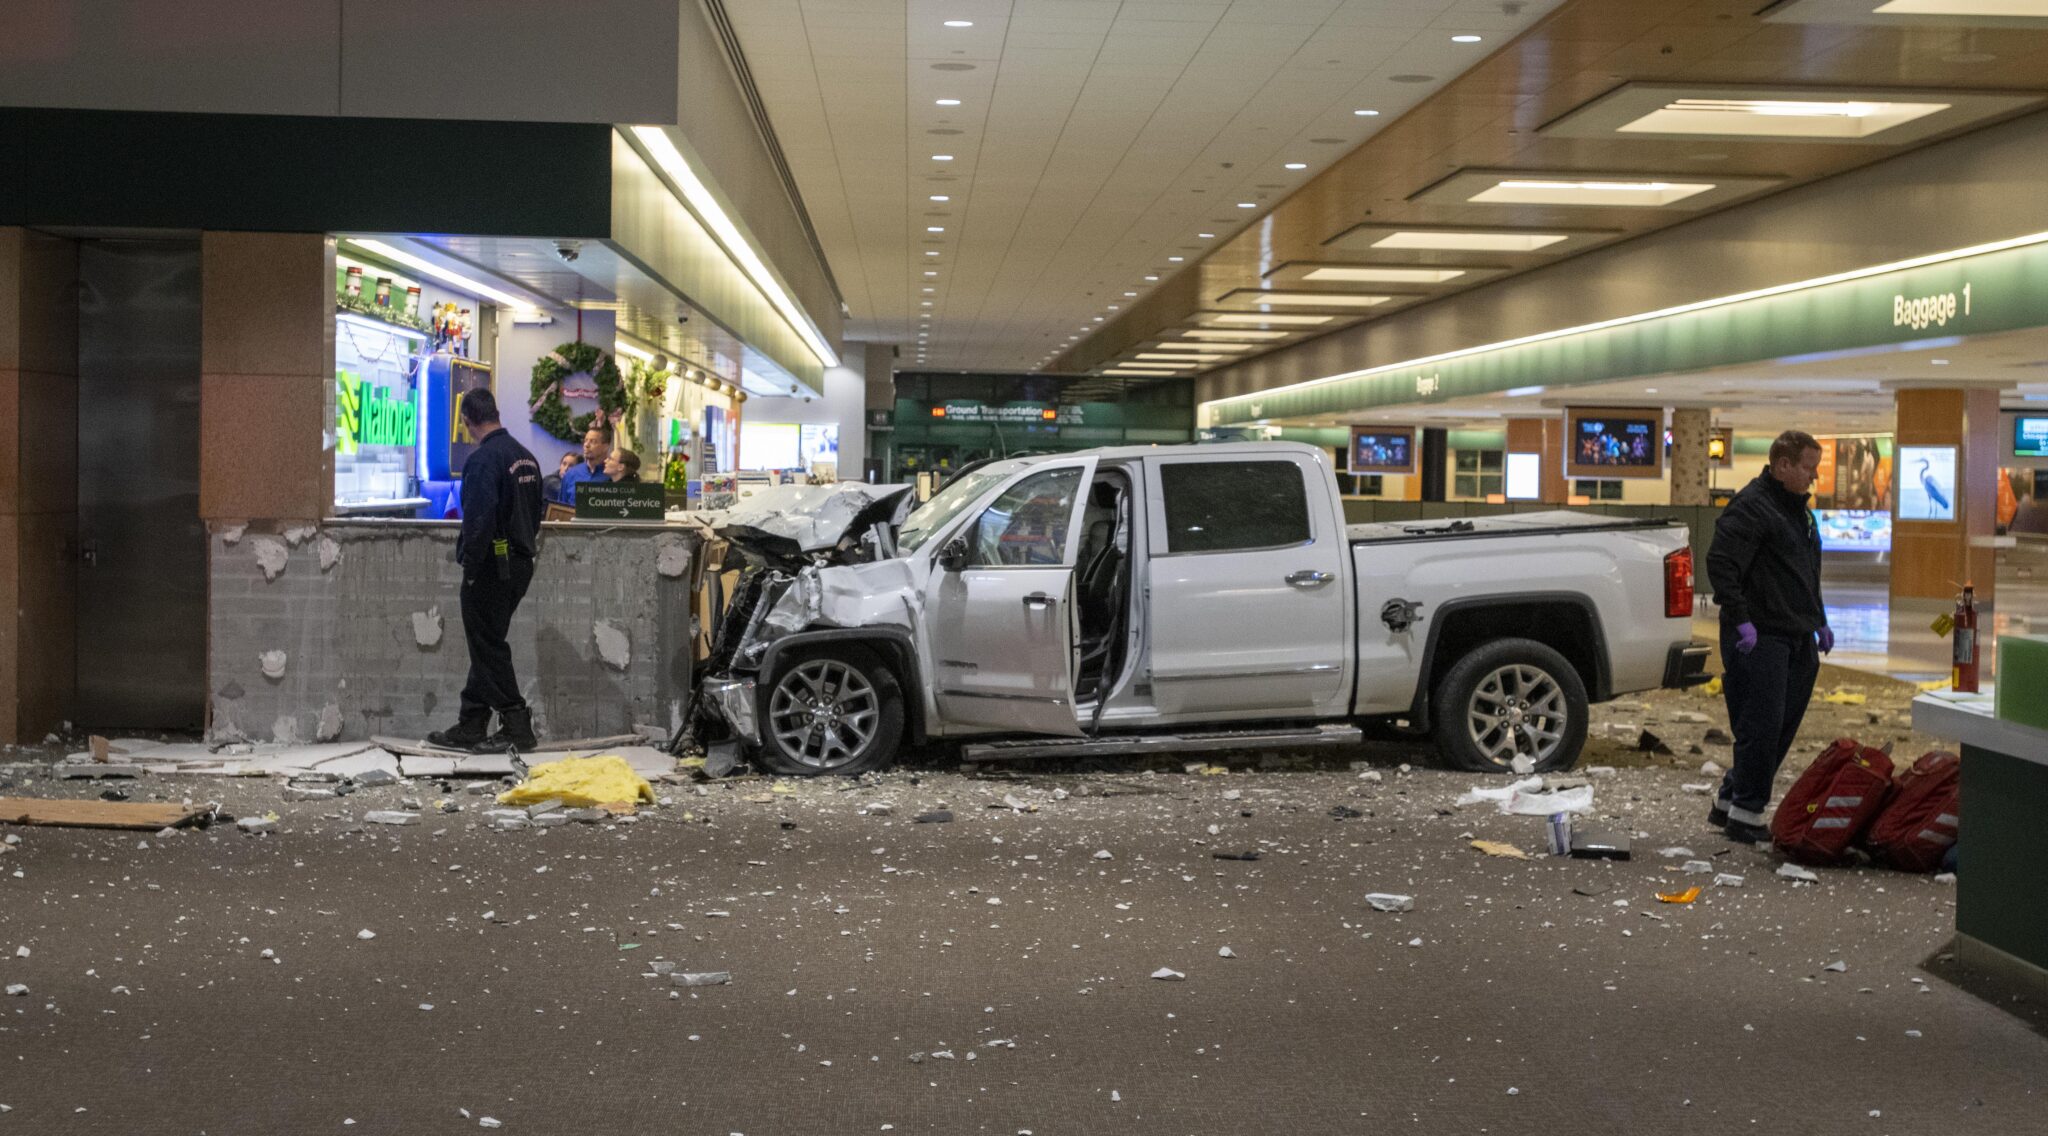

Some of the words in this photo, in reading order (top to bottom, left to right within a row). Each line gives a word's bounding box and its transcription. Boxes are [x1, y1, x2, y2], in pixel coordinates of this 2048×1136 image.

[1894, 292, 1957, 330] Baggage
[1963, 282, 1971, 316] 1
[360, 382, 418, 447] National
[945, 404, 978, 415] Ground
[980, 405, 1043, 416] Transportation
[588, 496, 626, 507] Counter
[627, 497, 661, 508] Service
